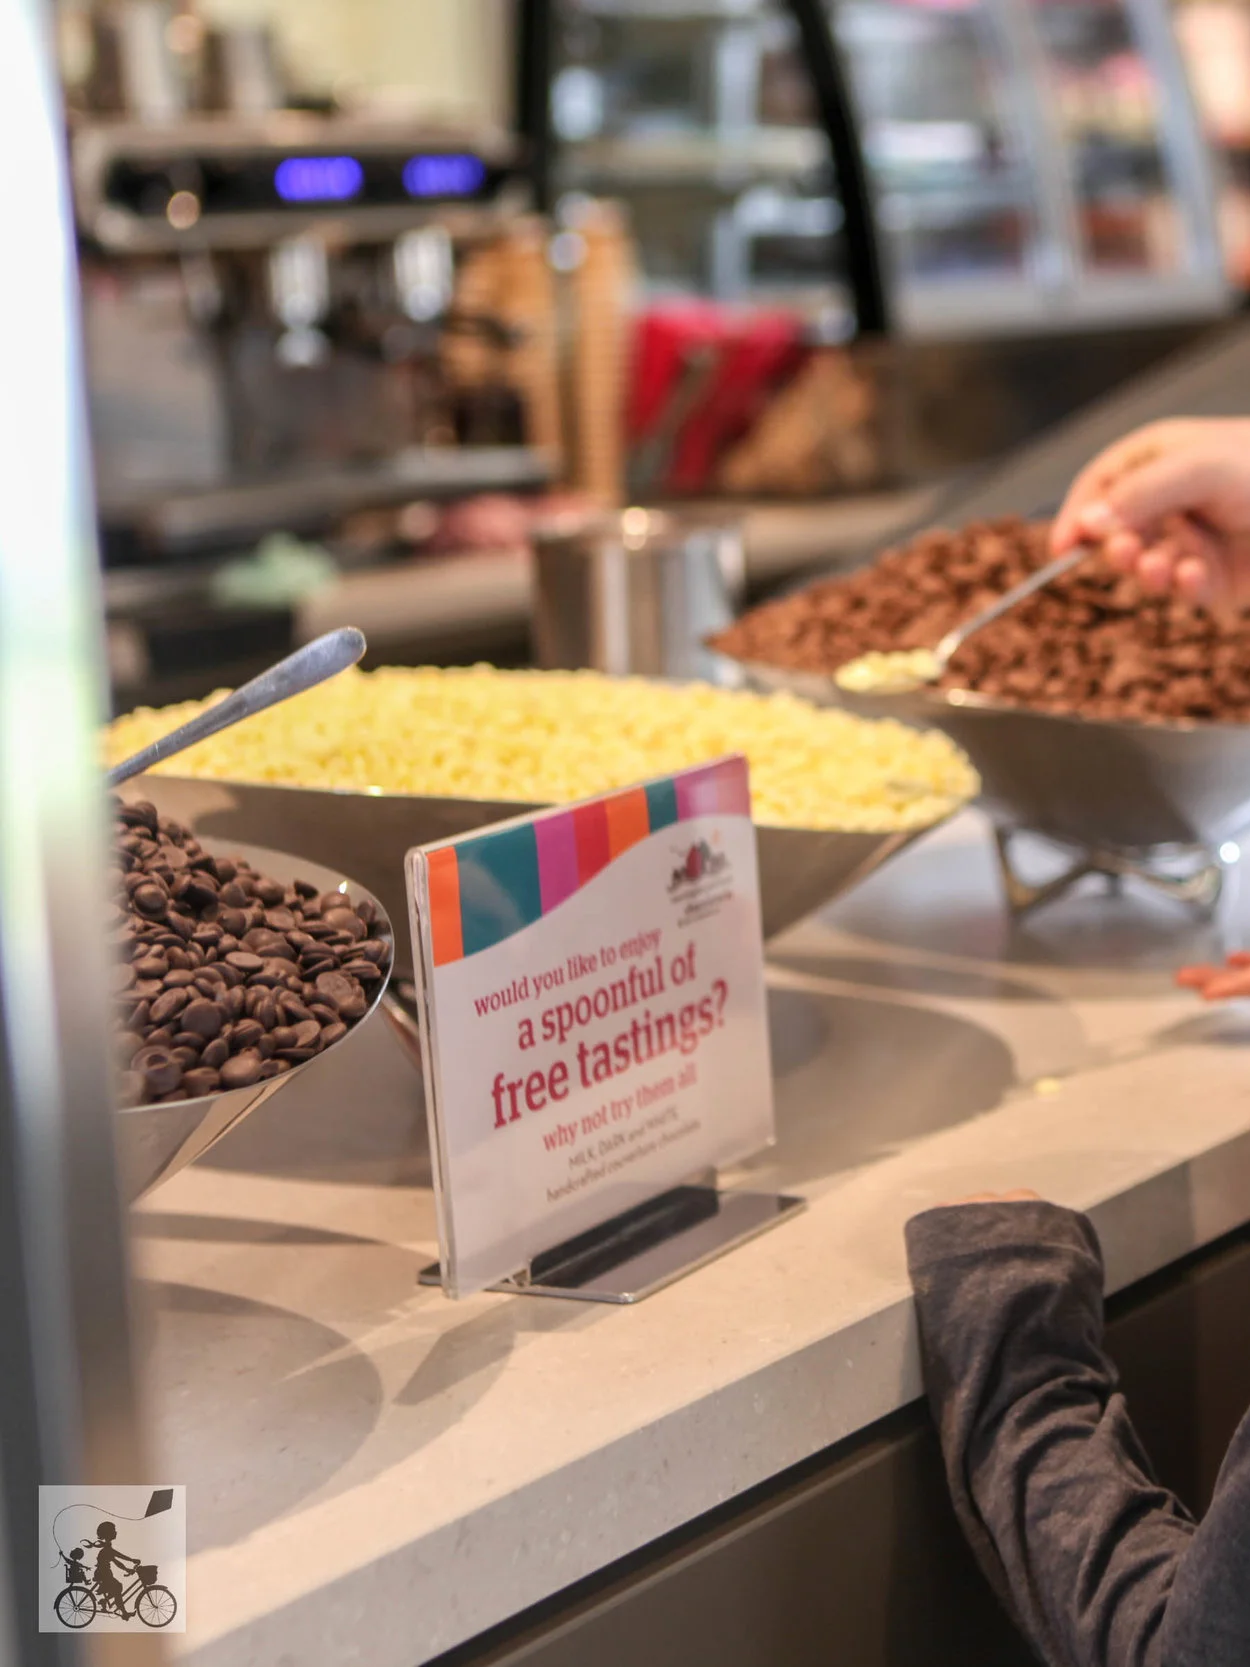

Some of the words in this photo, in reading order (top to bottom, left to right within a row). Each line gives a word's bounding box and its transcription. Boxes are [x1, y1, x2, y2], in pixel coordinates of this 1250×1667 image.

[474, 973, 530, 1018] would
[532, 966, 565, 1000] you
[566, 953, 598, 982] like
[599, 945, 617, 968] to
[619, 928, 662, 959] enjoy
[517, 1016, 537, 1051] a
[540, 955, 667, 1045] spoonful
[670, 942, 698, 986] of
[491, 1059, 570, 1130] free
[576, 976, 729, 1089] tastings?
[542, 1121, 578, 1152] why
[580, 1103, 609, 1136] not
[610, 1096, 634, 1121] try
[636, 1076, 676, 1109] them
[678, 1061, 698, 1090] all
